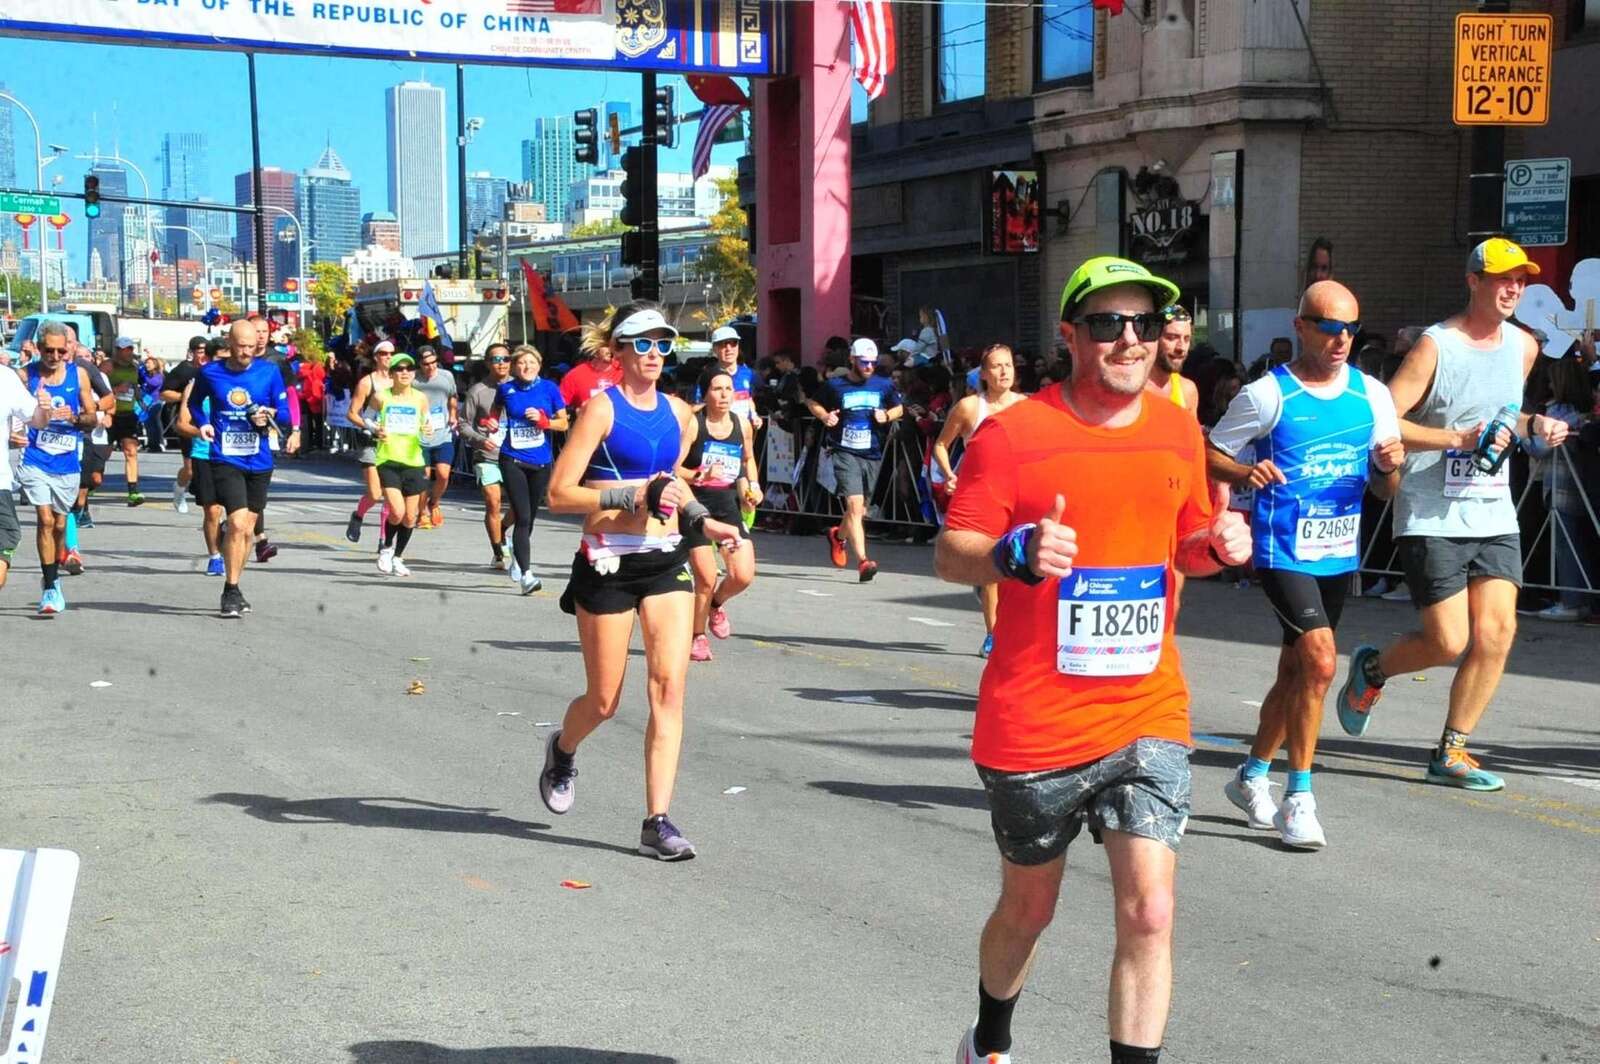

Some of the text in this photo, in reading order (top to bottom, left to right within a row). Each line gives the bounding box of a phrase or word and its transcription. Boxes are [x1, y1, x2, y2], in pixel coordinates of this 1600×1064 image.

[203, 0, 550, 33] OF THE REPUBLIC OF CHINA
[1461, 23, 1546, 41] RIGHT TURN
[1471, 45, 1536, 62] VERTICAL
[1462, 65, 1543, 83] CLEARANCE
[1131, 206, 1193, 236] NO.18
[1451, 459, 1461, 477] G
[1302, 516, 1356, 539] G 24684
[1069, 601, 1160, 637] F 18266
